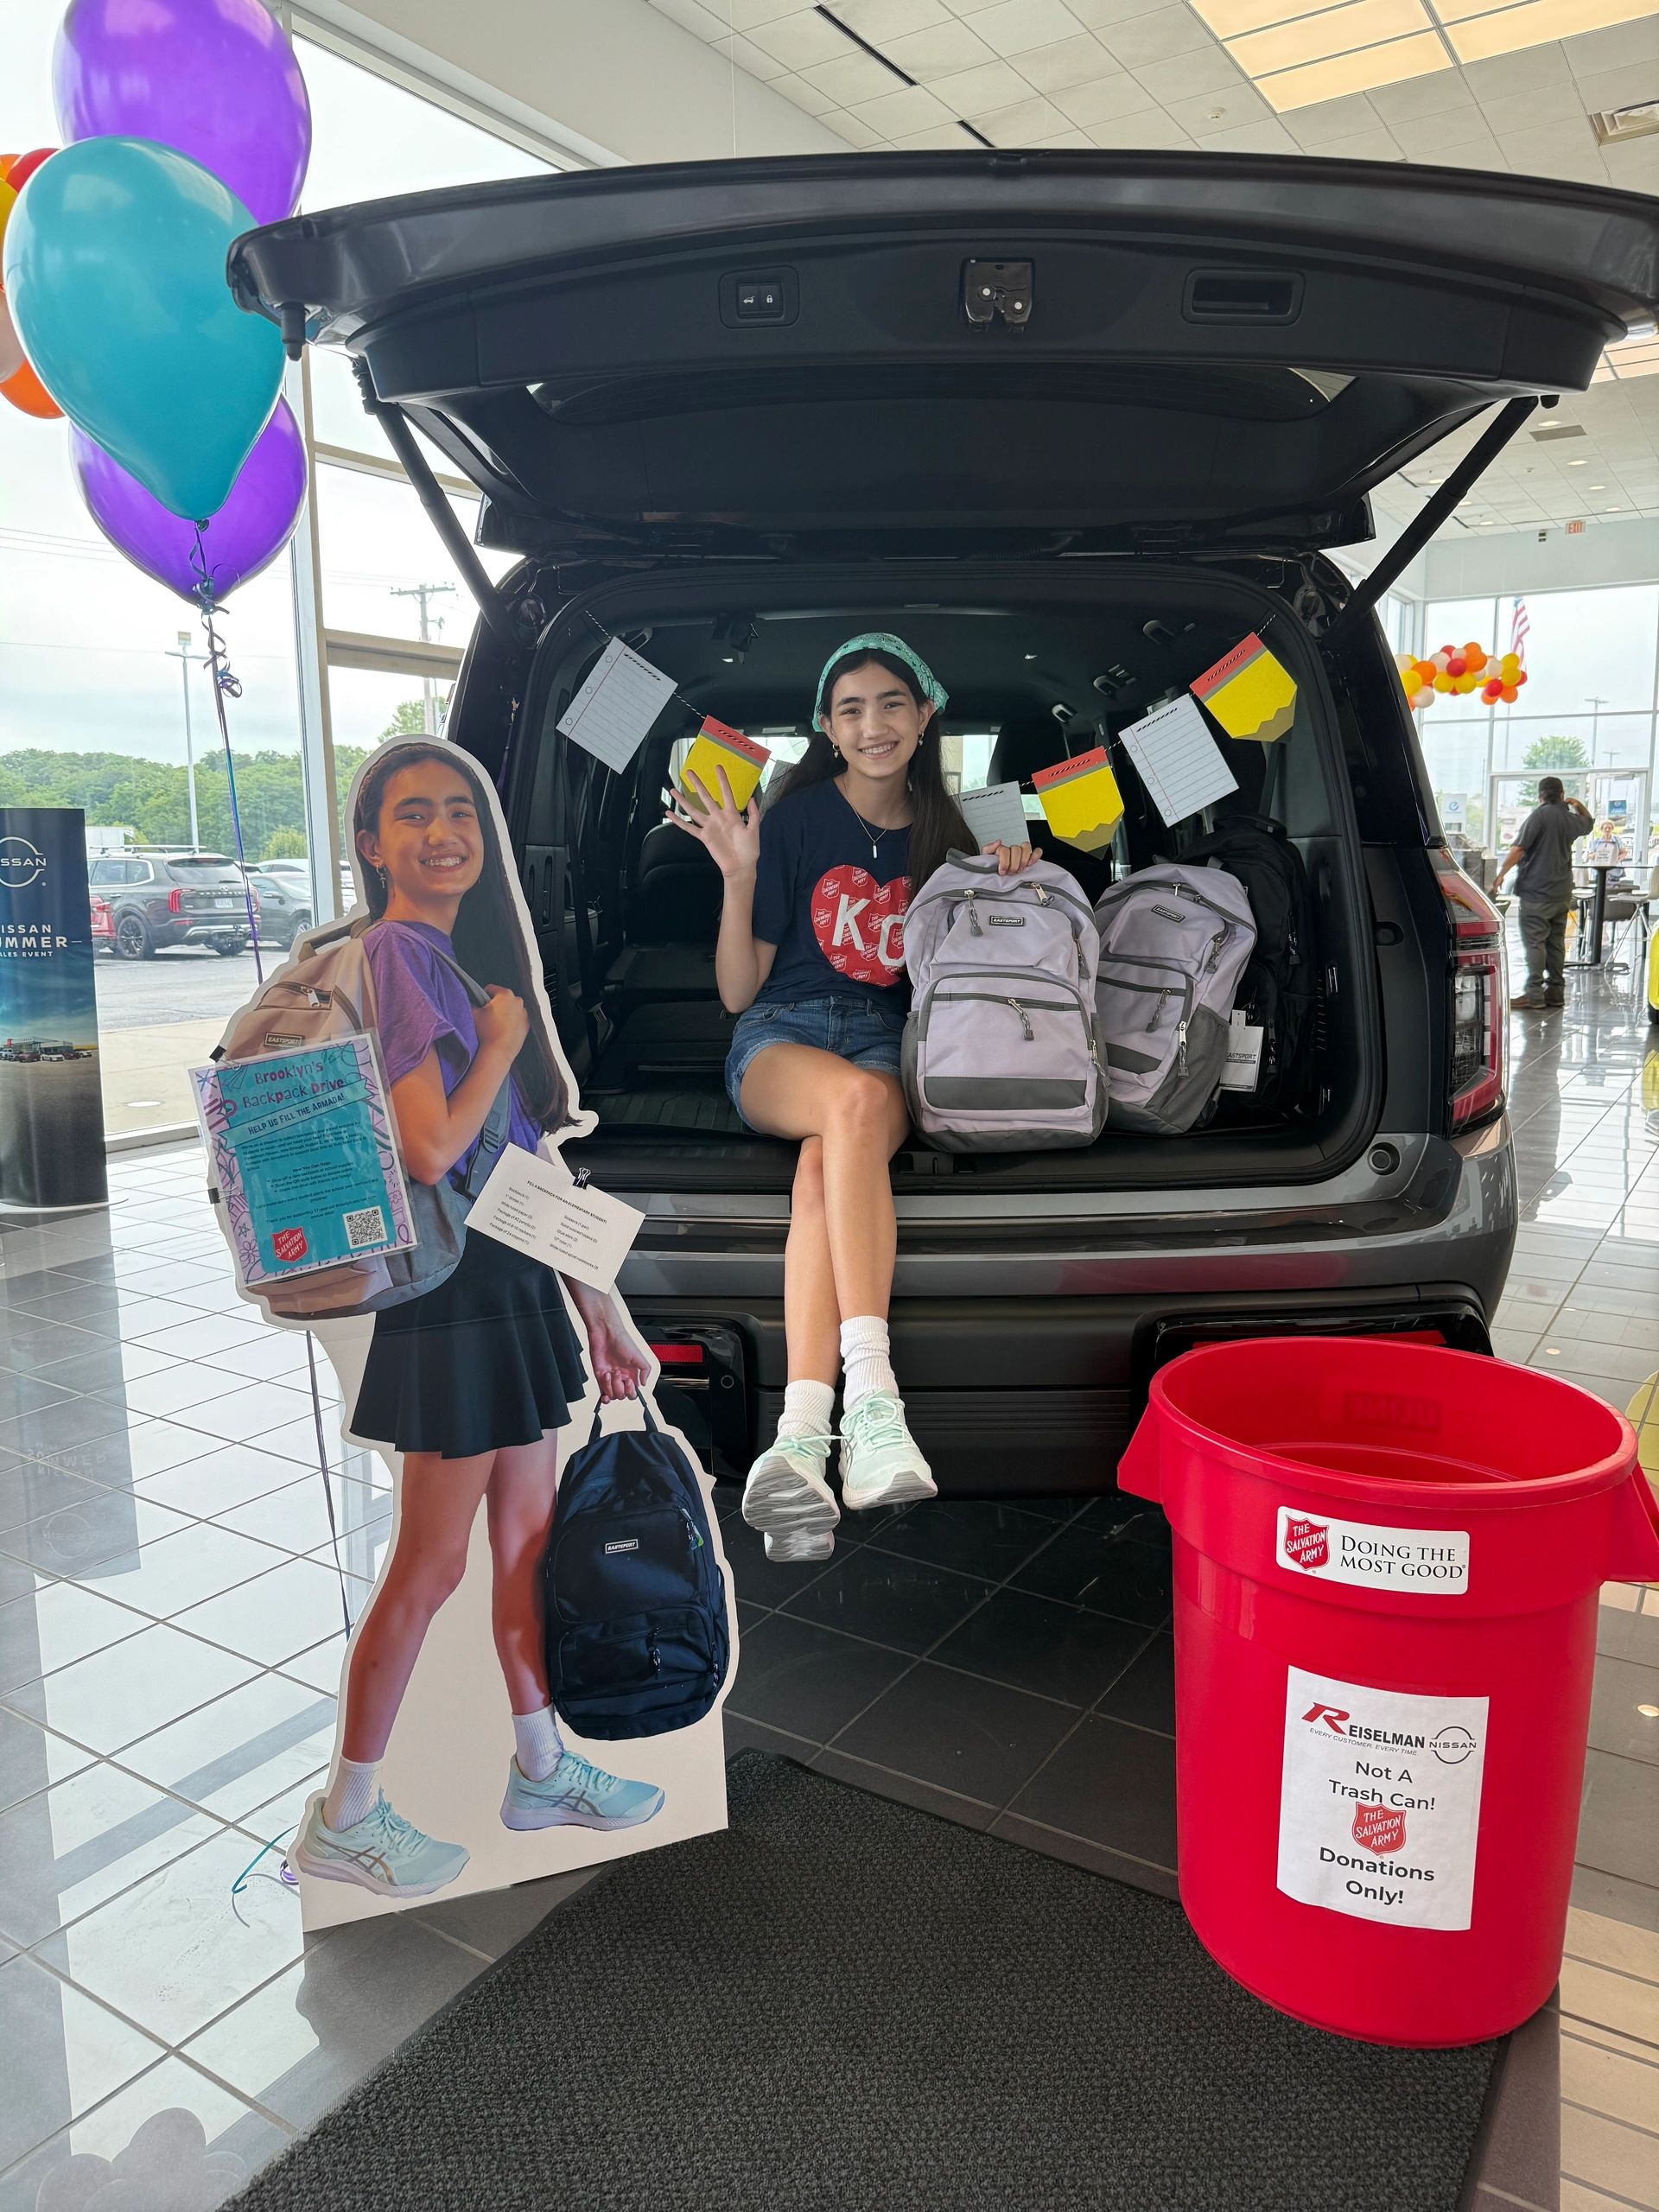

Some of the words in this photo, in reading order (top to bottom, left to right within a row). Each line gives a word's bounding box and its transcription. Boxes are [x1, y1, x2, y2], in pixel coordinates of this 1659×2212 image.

[0, 858, 47, 867] SSAN
[0, 925, 52, 933] ISSAN
[0, 936, 67, 949] MMER
[255, 1059, 324, 1085] Brooklyn's
[243, 1084, 307, 1109] Backpack
[311, 1077, 345, 1095] Drive
[248, 1122, 269, 1135] HELP
[280, 1111, 297, 1124] FILL
[297, 1105, 311, 1118] THE
[312, 1092, 346, 1113] ARMADA!
[276, 1230, 302, 1258] SALVATION
[278, 1231, 290, 1244] THE
[288, 1241, 303, 1259] ARMY
[1287, 1529, 1325, 1554] SALVATION
[1293, 1523, 1310, 1537] THE
[1300, 1544, 1324, 1563] ARMY
[1341, 1535, 1410, 1560] DOING
[1417, 1547, 1456, 1561] THE
[1340, 1554, 1395, 1574] MOST
[1301, 1701, 1425, 1749] REISELMAN
[1428, 1740, 1477, 1750] NISSAN
[1309, 1727, 1332, 1739] EVERY
[1375, 1744, 1400, 1754] EVERY
[1355, 1761, 1393, 1782] Not
[1397, 1770, 1414, 1783] A
[1328, 1779, 1383, 1803] Trash
[1389, 1794, 1436, 1811] Can!
[1356, 1815, 1402, 1839] SALVATION
[1363, 1809, 1384, 1823] THE
[1370, 1828, 1399, 1848] ARMY
[1319, 1847, 1435, 1882] Donations
[1345, 1880, 1405, 1906] Only!
